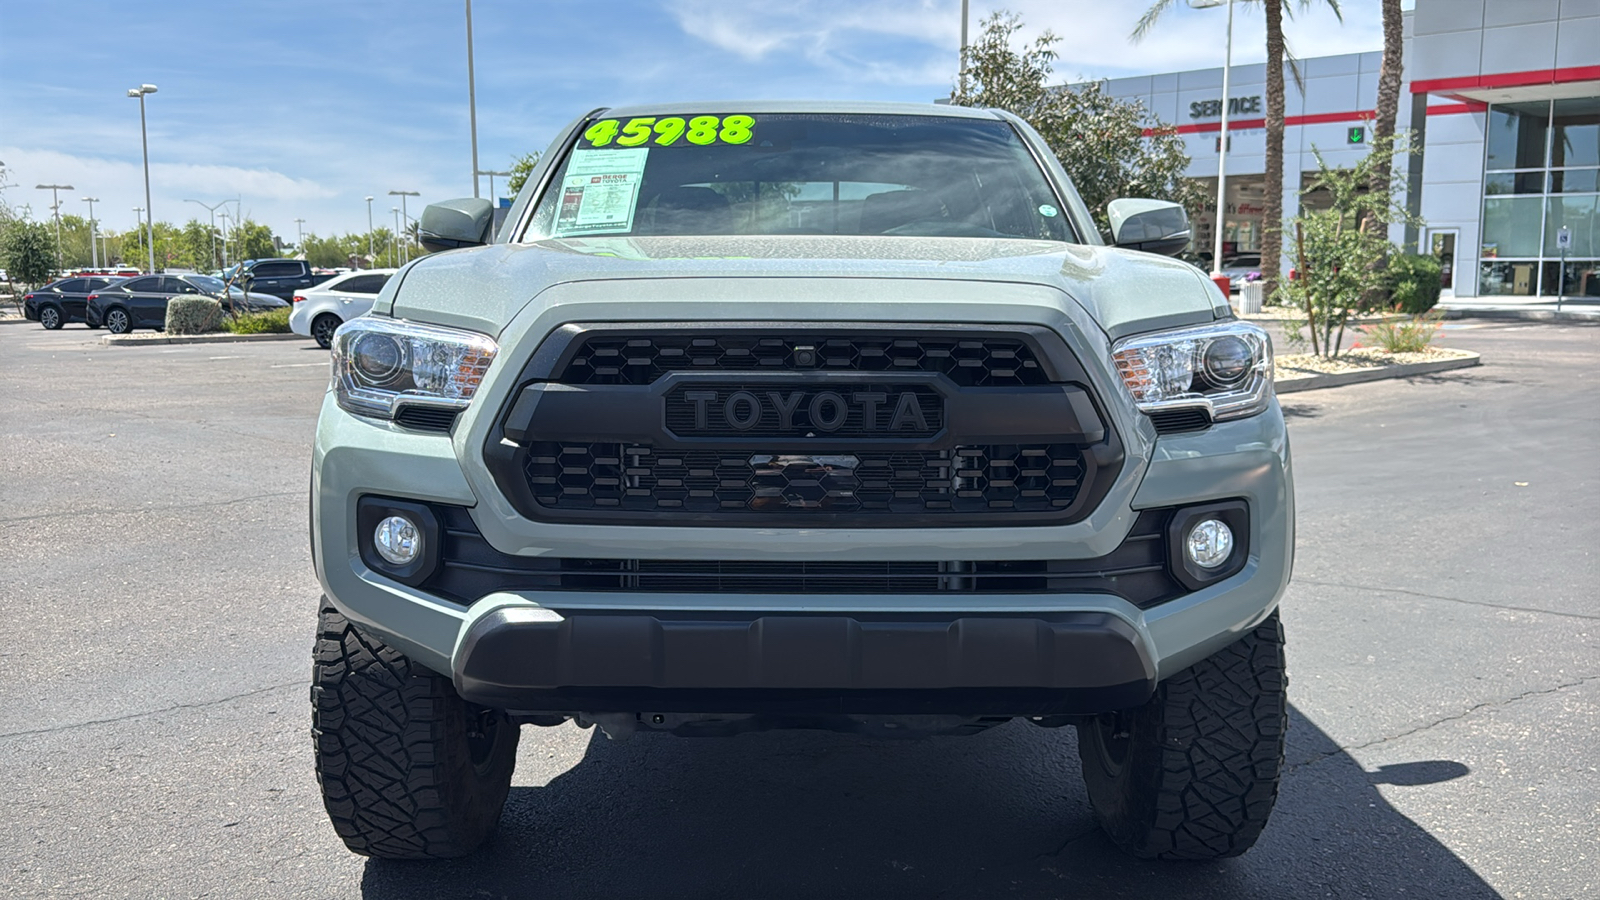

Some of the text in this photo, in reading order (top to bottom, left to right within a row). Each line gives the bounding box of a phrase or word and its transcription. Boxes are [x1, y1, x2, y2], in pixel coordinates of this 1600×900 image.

[1189, 96, 1261, 119] SERVICE
[584, 115, 755, 147] 45988
[684, 390, 929, 431] TOYOTA
